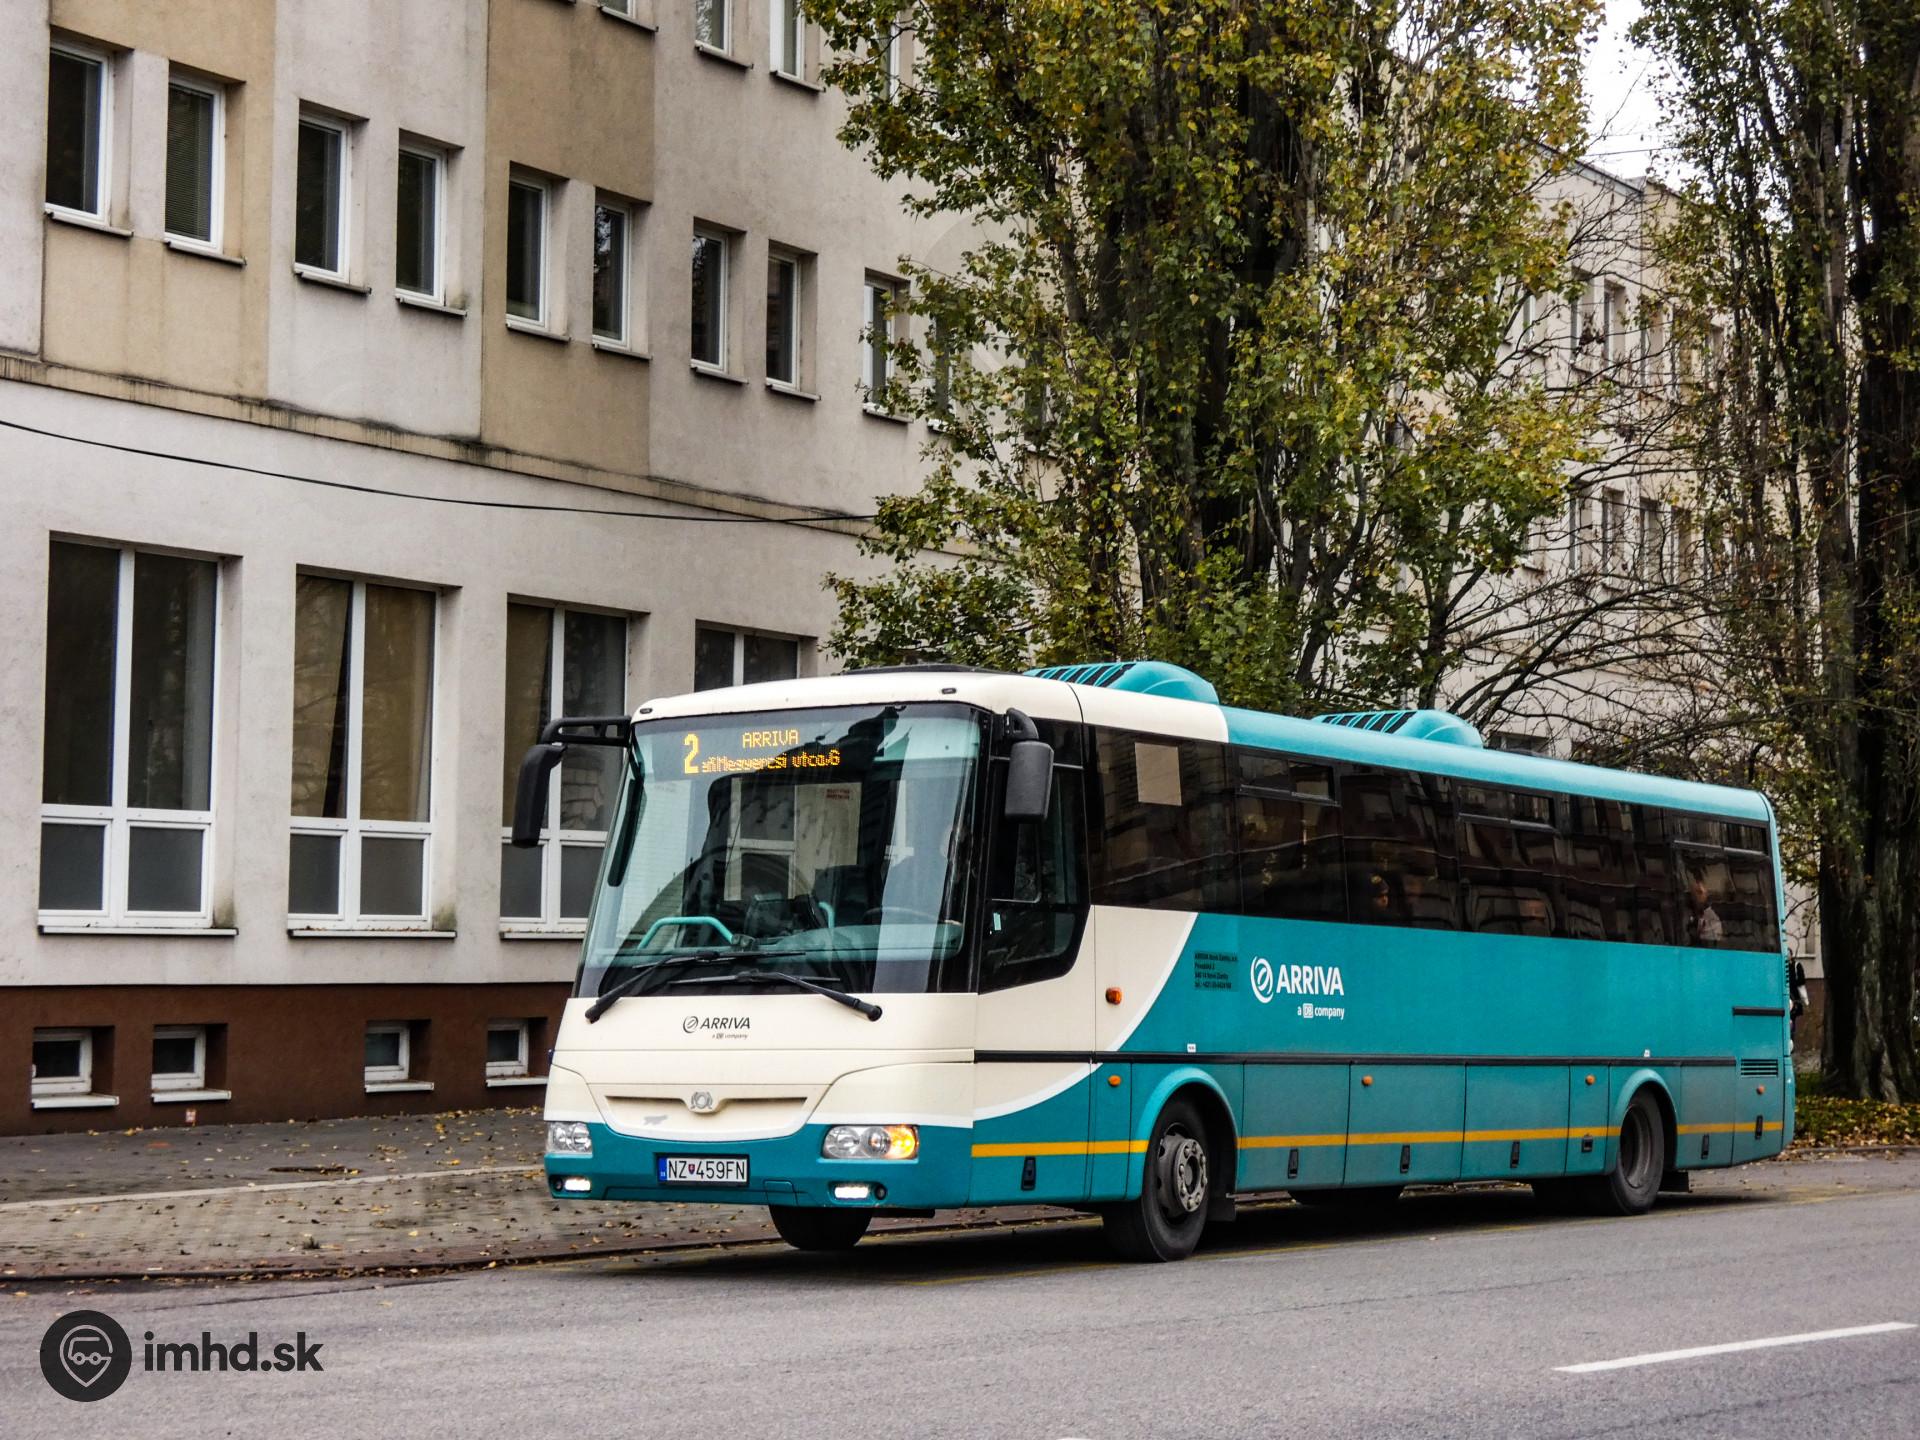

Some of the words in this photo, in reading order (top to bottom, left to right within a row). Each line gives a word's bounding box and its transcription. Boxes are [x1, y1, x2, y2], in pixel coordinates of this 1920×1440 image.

[742, 730, 799, 748] ARRIVA
[684, 733, 699, 774] 2
[1276, 964, 1345, 996] ARRIVA
[1297, 1006, 1302, 1016] a
[1315, 1006, 1345, 1020] company
[700, 1017, 750, 1029] ARRIVA
